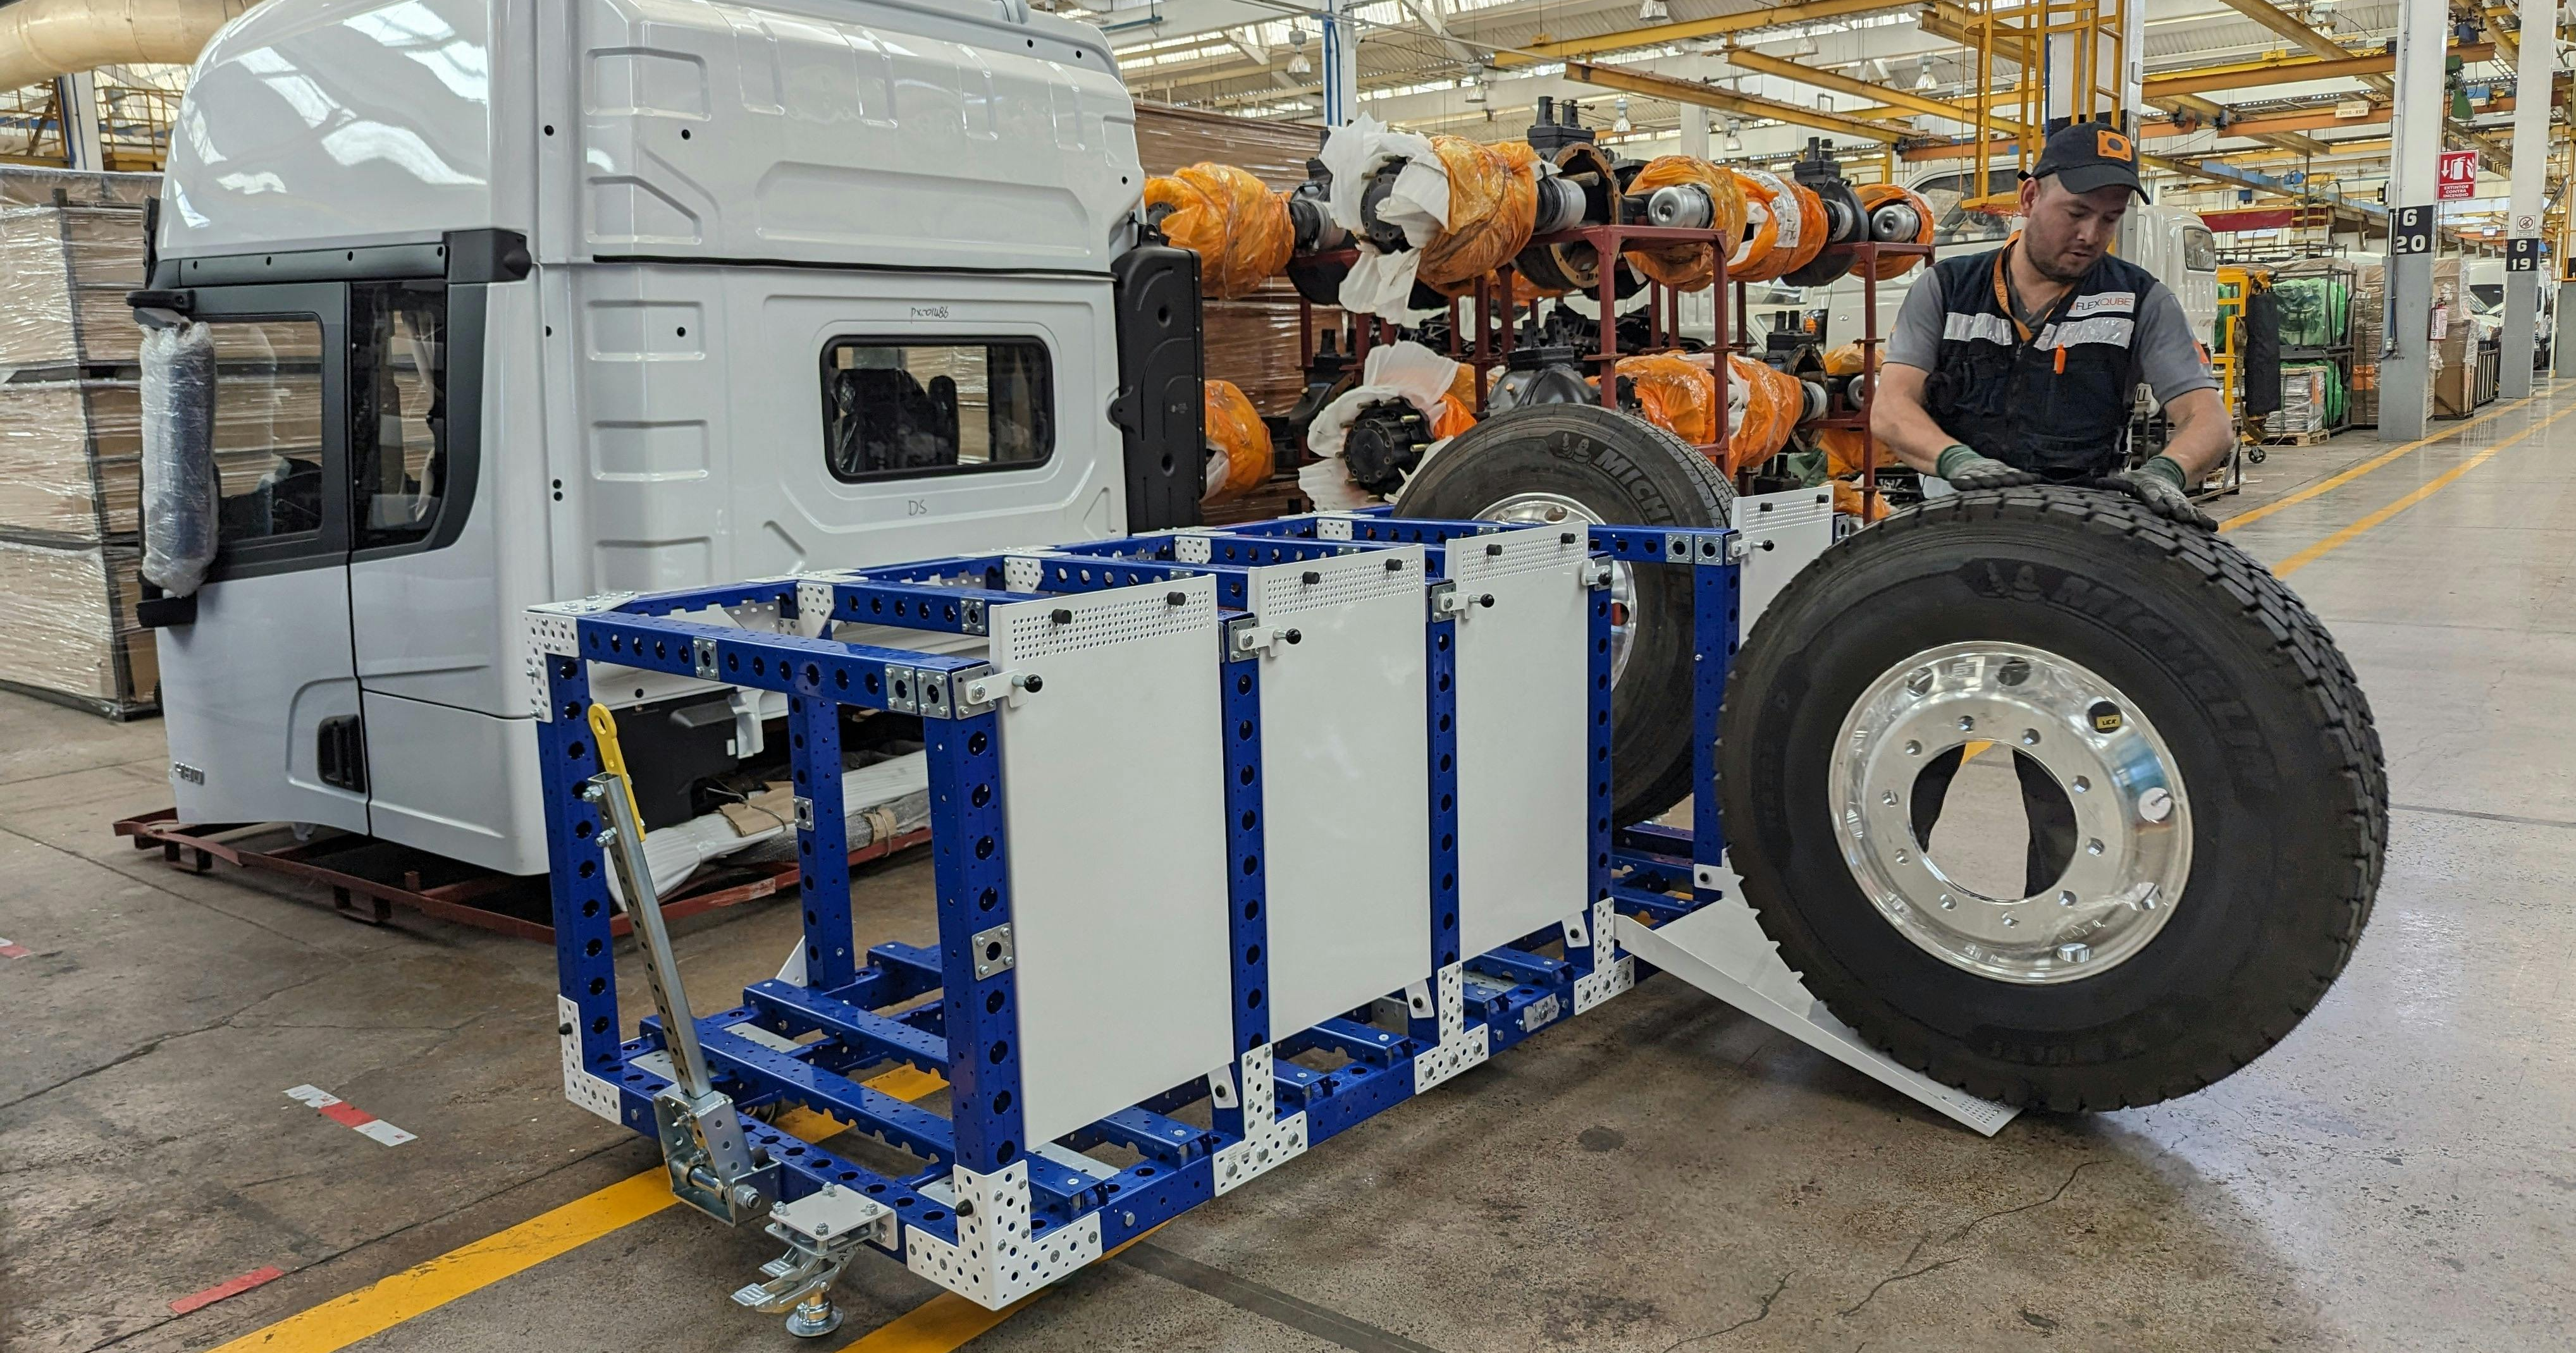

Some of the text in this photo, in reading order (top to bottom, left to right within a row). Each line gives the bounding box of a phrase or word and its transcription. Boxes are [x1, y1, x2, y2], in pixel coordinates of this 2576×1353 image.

[2403, 209, 2417, 226] G
[2393, 235, 2425, 253] 20
[2516, 240, 2527, 252] G
[2511, 258, 2531, 271] 19
[2076, 297, 2133, 310] FLEXQUBE
[909, 499, 927, 516] DS
